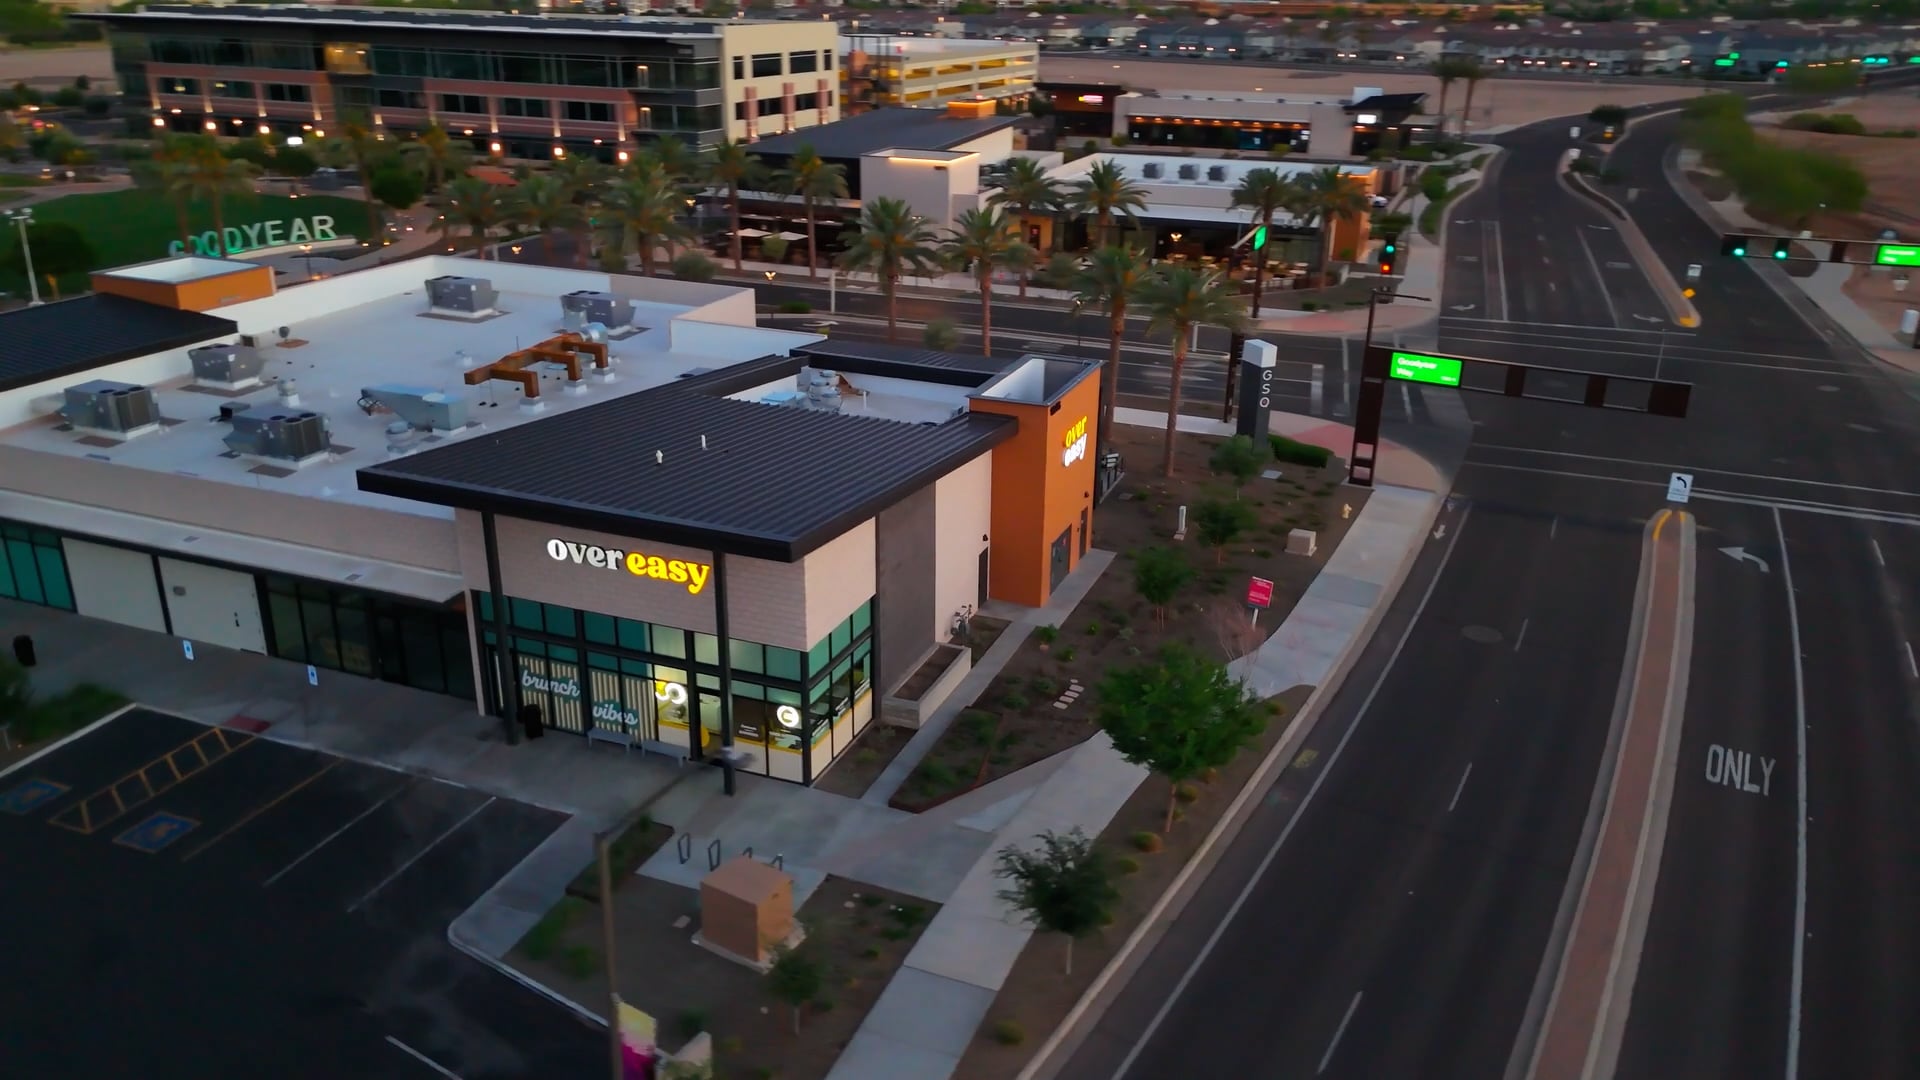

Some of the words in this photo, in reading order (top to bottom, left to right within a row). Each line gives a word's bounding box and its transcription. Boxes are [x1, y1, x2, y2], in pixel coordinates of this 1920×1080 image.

[1065, 415, 1087, 449] over
[547, 538, 624, 570] over
[626, 552, 709, 595] easy
[522, 669, 580, 697] brunch
[592, 703, 638, 726] vibes
[1705, 743, 1776, 797] ONLY
